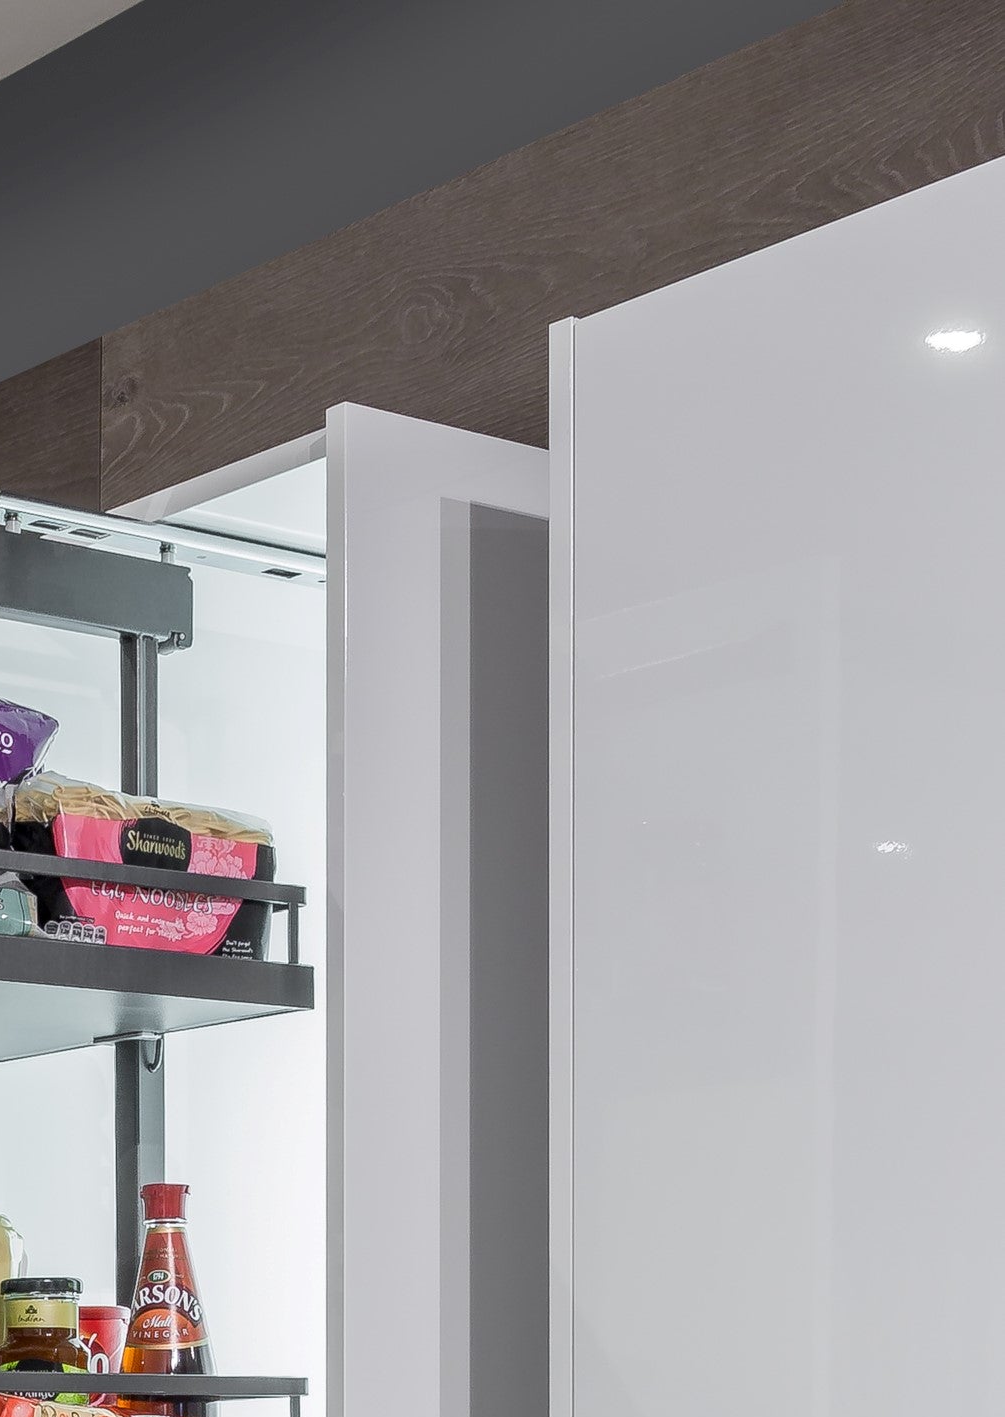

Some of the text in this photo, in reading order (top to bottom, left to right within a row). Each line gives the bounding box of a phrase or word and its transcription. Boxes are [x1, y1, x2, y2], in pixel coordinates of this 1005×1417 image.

[127, 830, 186, 860] Sharwood's
[92, 881, 213, 914] EGG NOODLES
[115, 910, 135, 921] Quick
[137, 914, 149, 922] and
[117, 924, 143, 935] perfect
[132, 1284, 202, 1321] ARSON'S
[18, 1315, 45, 1323] Indian
[143, 1315, 171, 1328] Malt
[132, 1329, 189, 1338] VINEGAR
